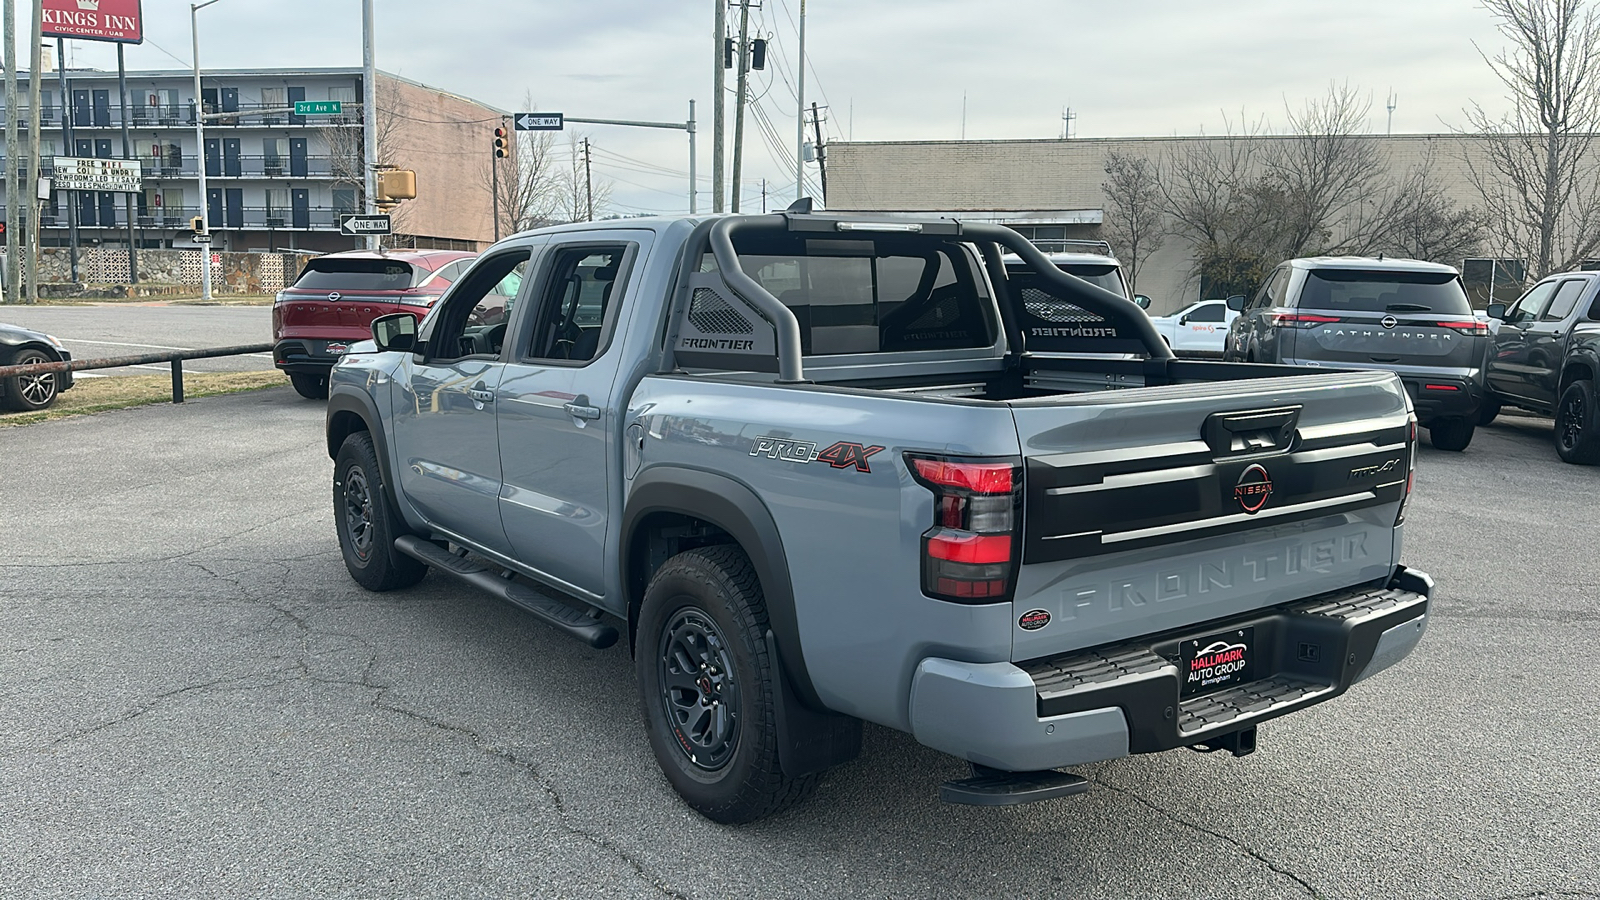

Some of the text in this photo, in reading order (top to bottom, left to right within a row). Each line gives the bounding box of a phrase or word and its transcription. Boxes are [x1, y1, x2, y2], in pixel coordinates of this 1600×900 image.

[42, 9, 136, 30] KINGS INN
[299, 104, 311, 112] 3rd
[315, 104, 327, 112] Ave
[353, 221, 370, 229] ONE
[1323, 329, 1451, 340] PATHFINDER
[681, 337, 754, 350] FRONTIER
[1234, 483, 1273, 496] NISSAN
[1058, 531, 1368, 622] FRONTIER
[1191, 648, 1243, 671] HALLMARK
[1187, 660, 1246, 683] AUTO GROUP
[1201, 674, 1231, 686] Birmingham
